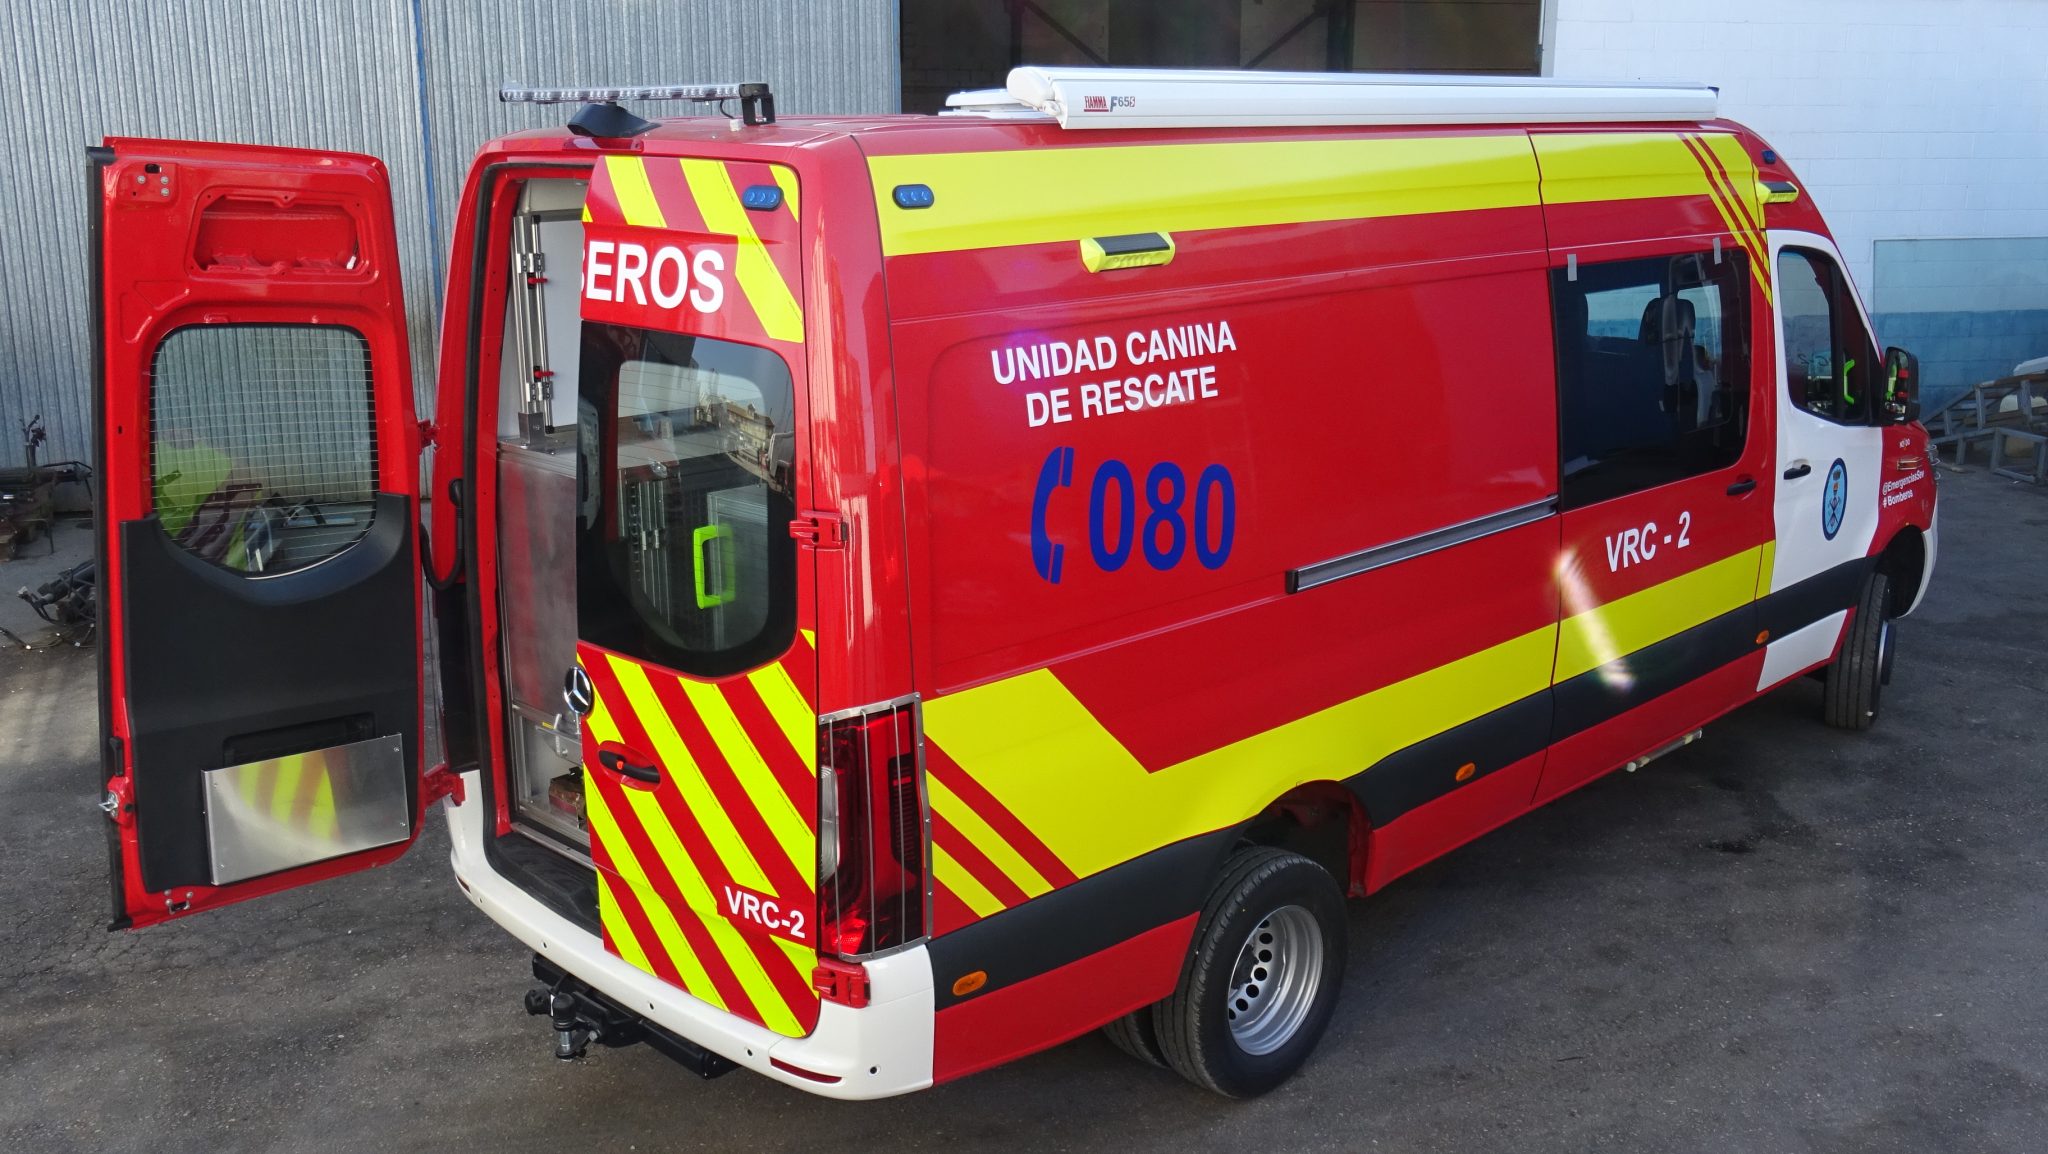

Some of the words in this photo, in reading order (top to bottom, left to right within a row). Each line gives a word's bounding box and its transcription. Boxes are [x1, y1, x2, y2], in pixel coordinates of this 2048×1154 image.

[1084, 96, 1109, 112] FIAMMA
[581, 240, 725, 313] EROS
[991, 336, 1117, 385] UNIDAD
[1126, 321, 1237, 366] CANINA
[1026, 388, 1073, 428] DE
[1080, 365, 1218, 418] RESCATE
[1089, 459, 1236, 572] 080
[1605, 522, 1658, 573] VRC
[1677, 510, 1691, 549] 2
[724, 885, 806, 939] VRC-2
